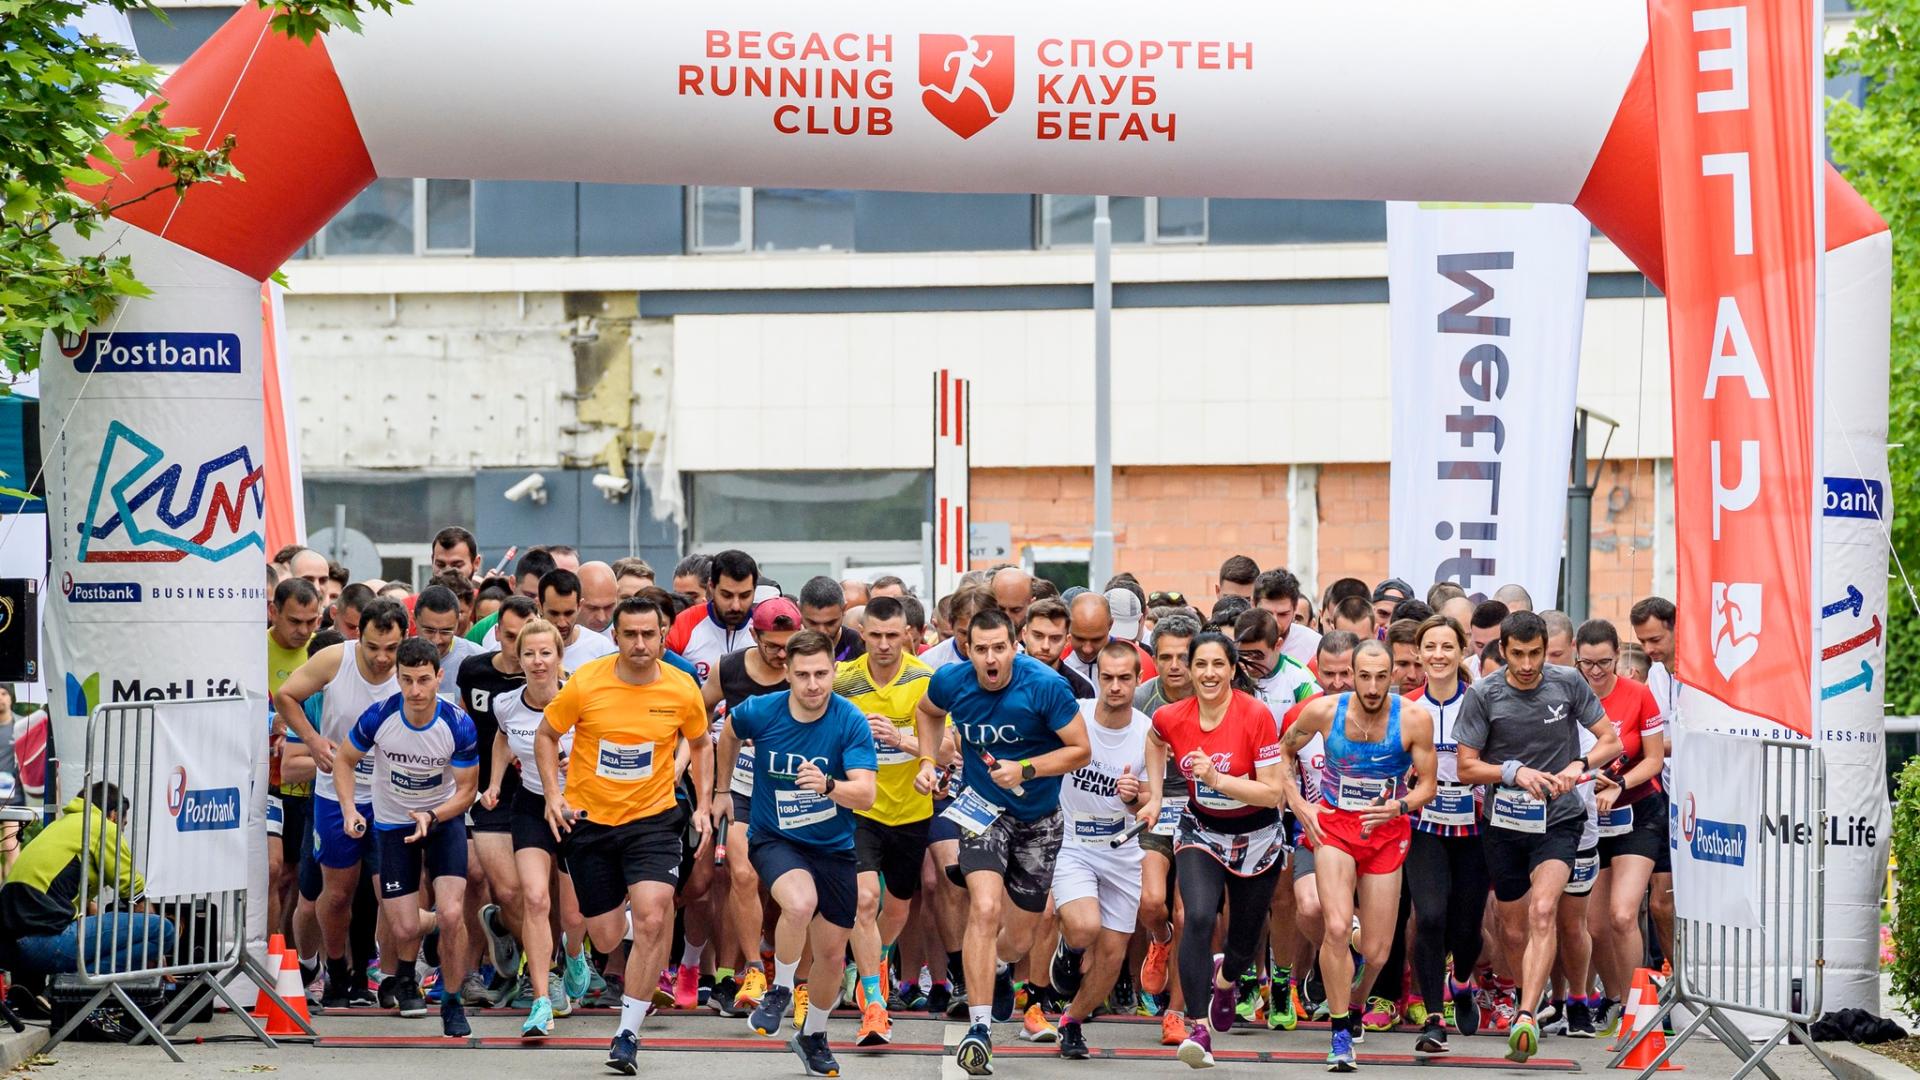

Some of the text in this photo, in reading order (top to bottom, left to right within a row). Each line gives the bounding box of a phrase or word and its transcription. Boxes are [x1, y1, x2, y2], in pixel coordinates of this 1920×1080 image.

[705, 29, 894, 63] BEGACH
[1037, 38, 1254, 71] СПОРТЕН
[679, 64, 894, 100] RUNNING
[1037, 73, 1157, 107] КЛУБ
[772, 104, 894, 137] CLUB
[1036, 111, 1177, 142] БЕГАЧ
[95, 338, 232, 367] Postbank
[75, 584, 135, 600] Postbank
[382, 750, 446, 766] vmware
[1072, 776, 1117, 798] TEAM
[185, 795, 236, 823] Postbank
[1696, 826, 1744, 858] Postbank
[1759, 814, 1877, 848] MeLife
